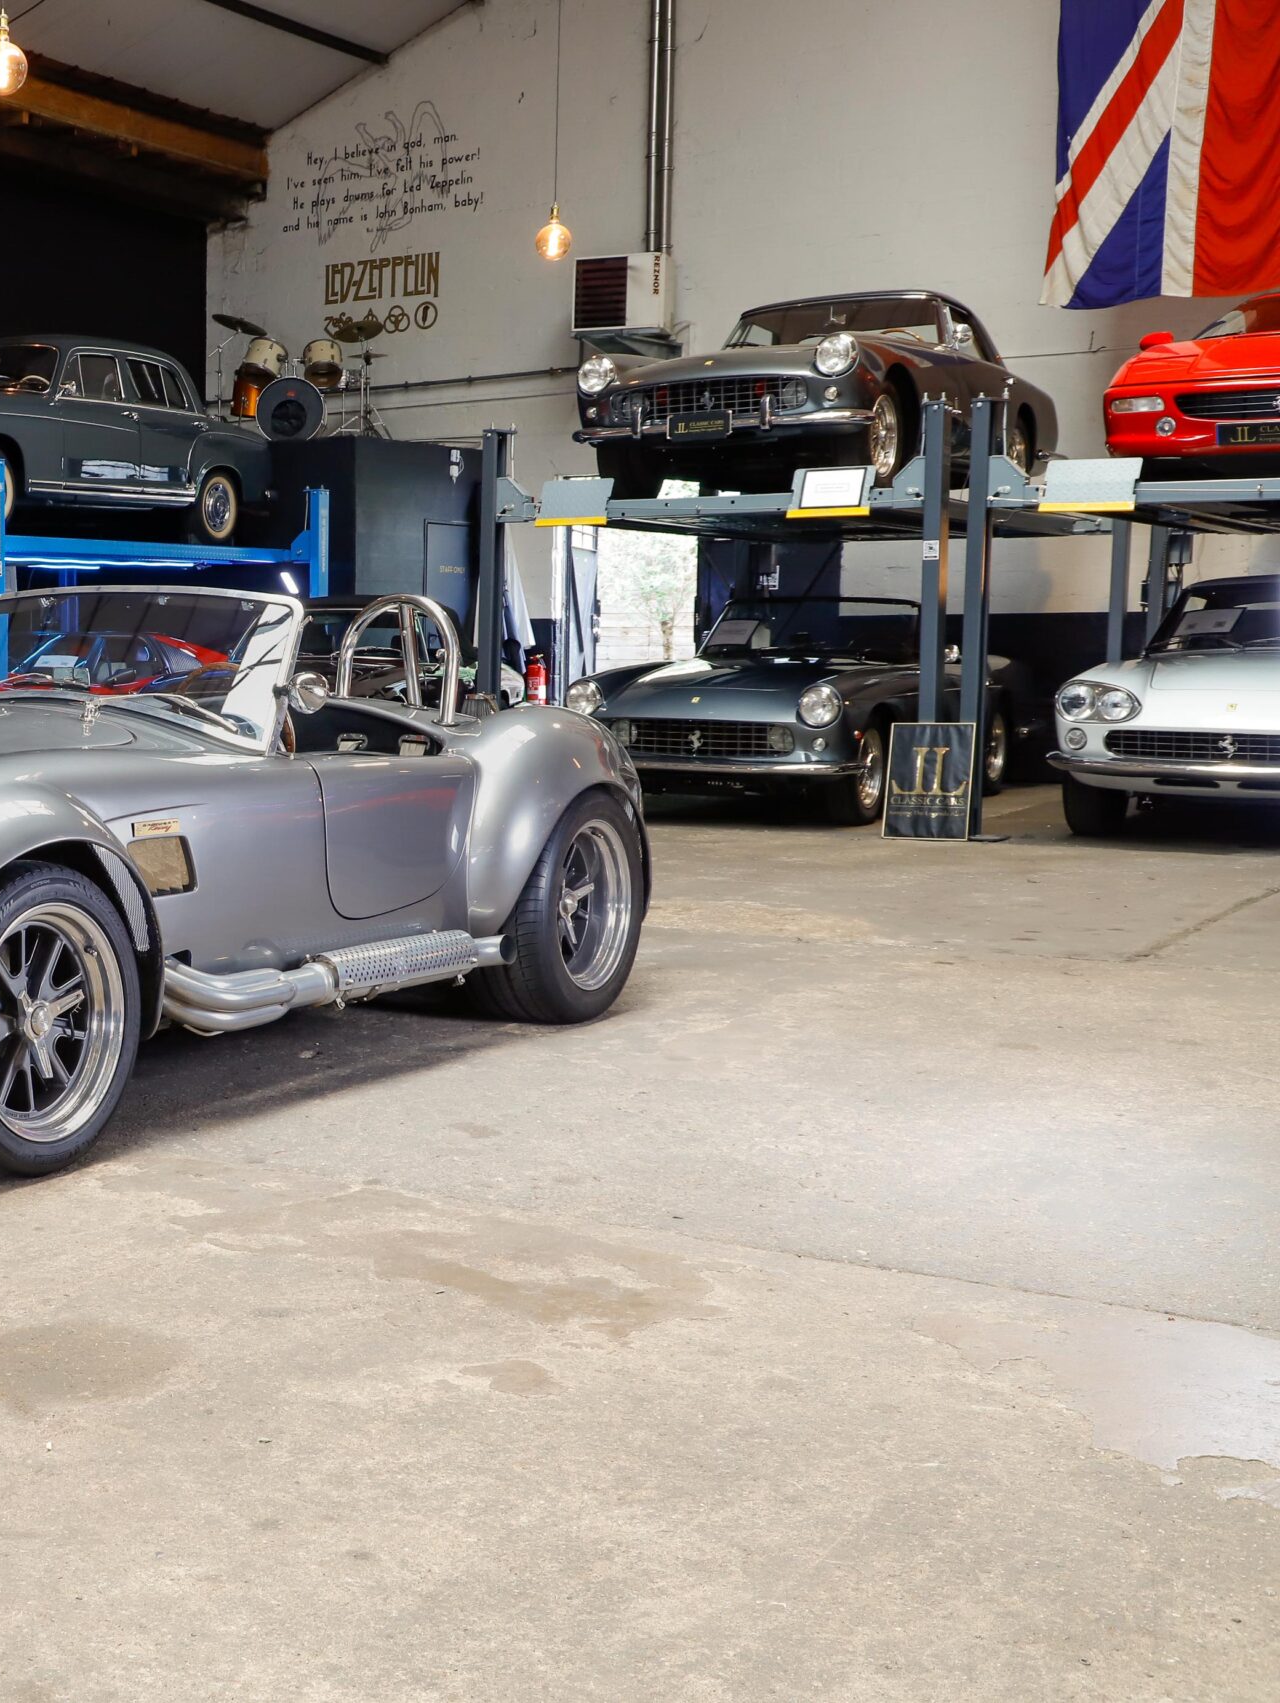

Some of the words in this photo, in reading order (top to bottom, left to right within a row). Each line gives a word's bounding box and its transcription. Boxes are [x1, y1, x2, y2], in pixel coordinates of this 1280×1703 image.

[287, 177, 305, 190] I've
[312, 176, 335, 188] seen
[341, 167, 363, 182] him,
[370, 163, 389, 177] I've
[396, 157, 413, 172] felt
[419, 153, 434, 169] his
[441, 147, 481, 173] power!
[306, 152, 328, 171] Hey,
[344, 144, 380, 160] believe
[386, 143, 397, 153] in
[283, 217, 300, 233] and
[307, 214, 320, 230] his
[327, 215, 354, 227] name
[361, 207, 368, 221] is
[376, 203, 397, 219] John
[403, 199, 447, 216] Bonham,
[454, 192, 484, 213] baby!
[293, 196, 305, 211] He
[311, 192, 336, 214] plays
[343, 188, 375, 203] drums
[382, 182, 397, 197] for
[403, 175, 422, 194] Led
[429, 170, 474, 196] Zeppelin
[652, 255, 661, 296] REZNOR
[890, 796, 932, 806] CLASSIC
